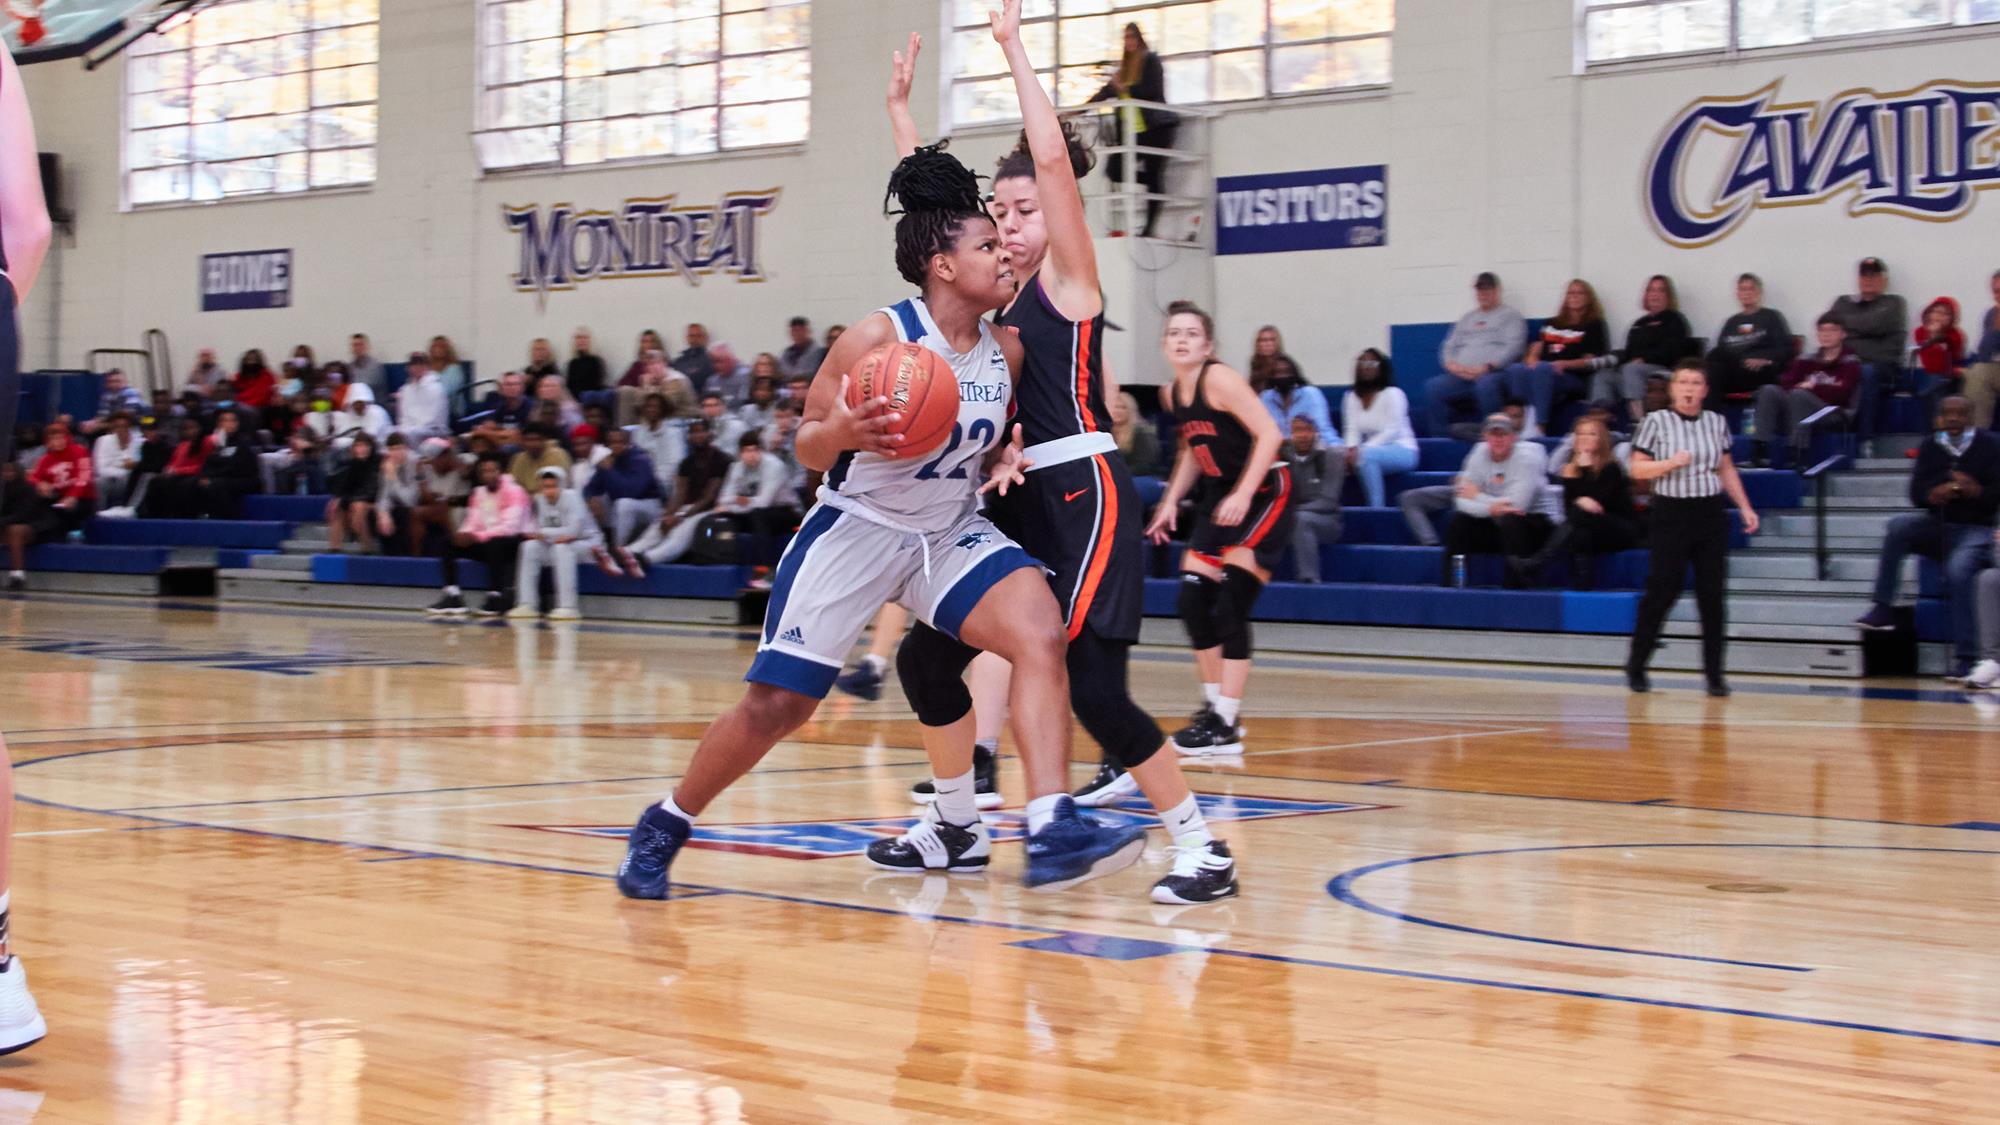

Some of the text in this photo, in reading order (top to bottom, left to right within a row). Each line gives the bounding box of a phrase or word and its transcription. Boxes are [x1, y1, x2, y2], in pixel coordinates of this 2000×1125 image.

[1218, 180, 1385, 228] VISITORS
[502, 188, 781, 298] MONTREAT
[202, 252, 289, 295] HOME
[913, 418, 995, 480] 22
